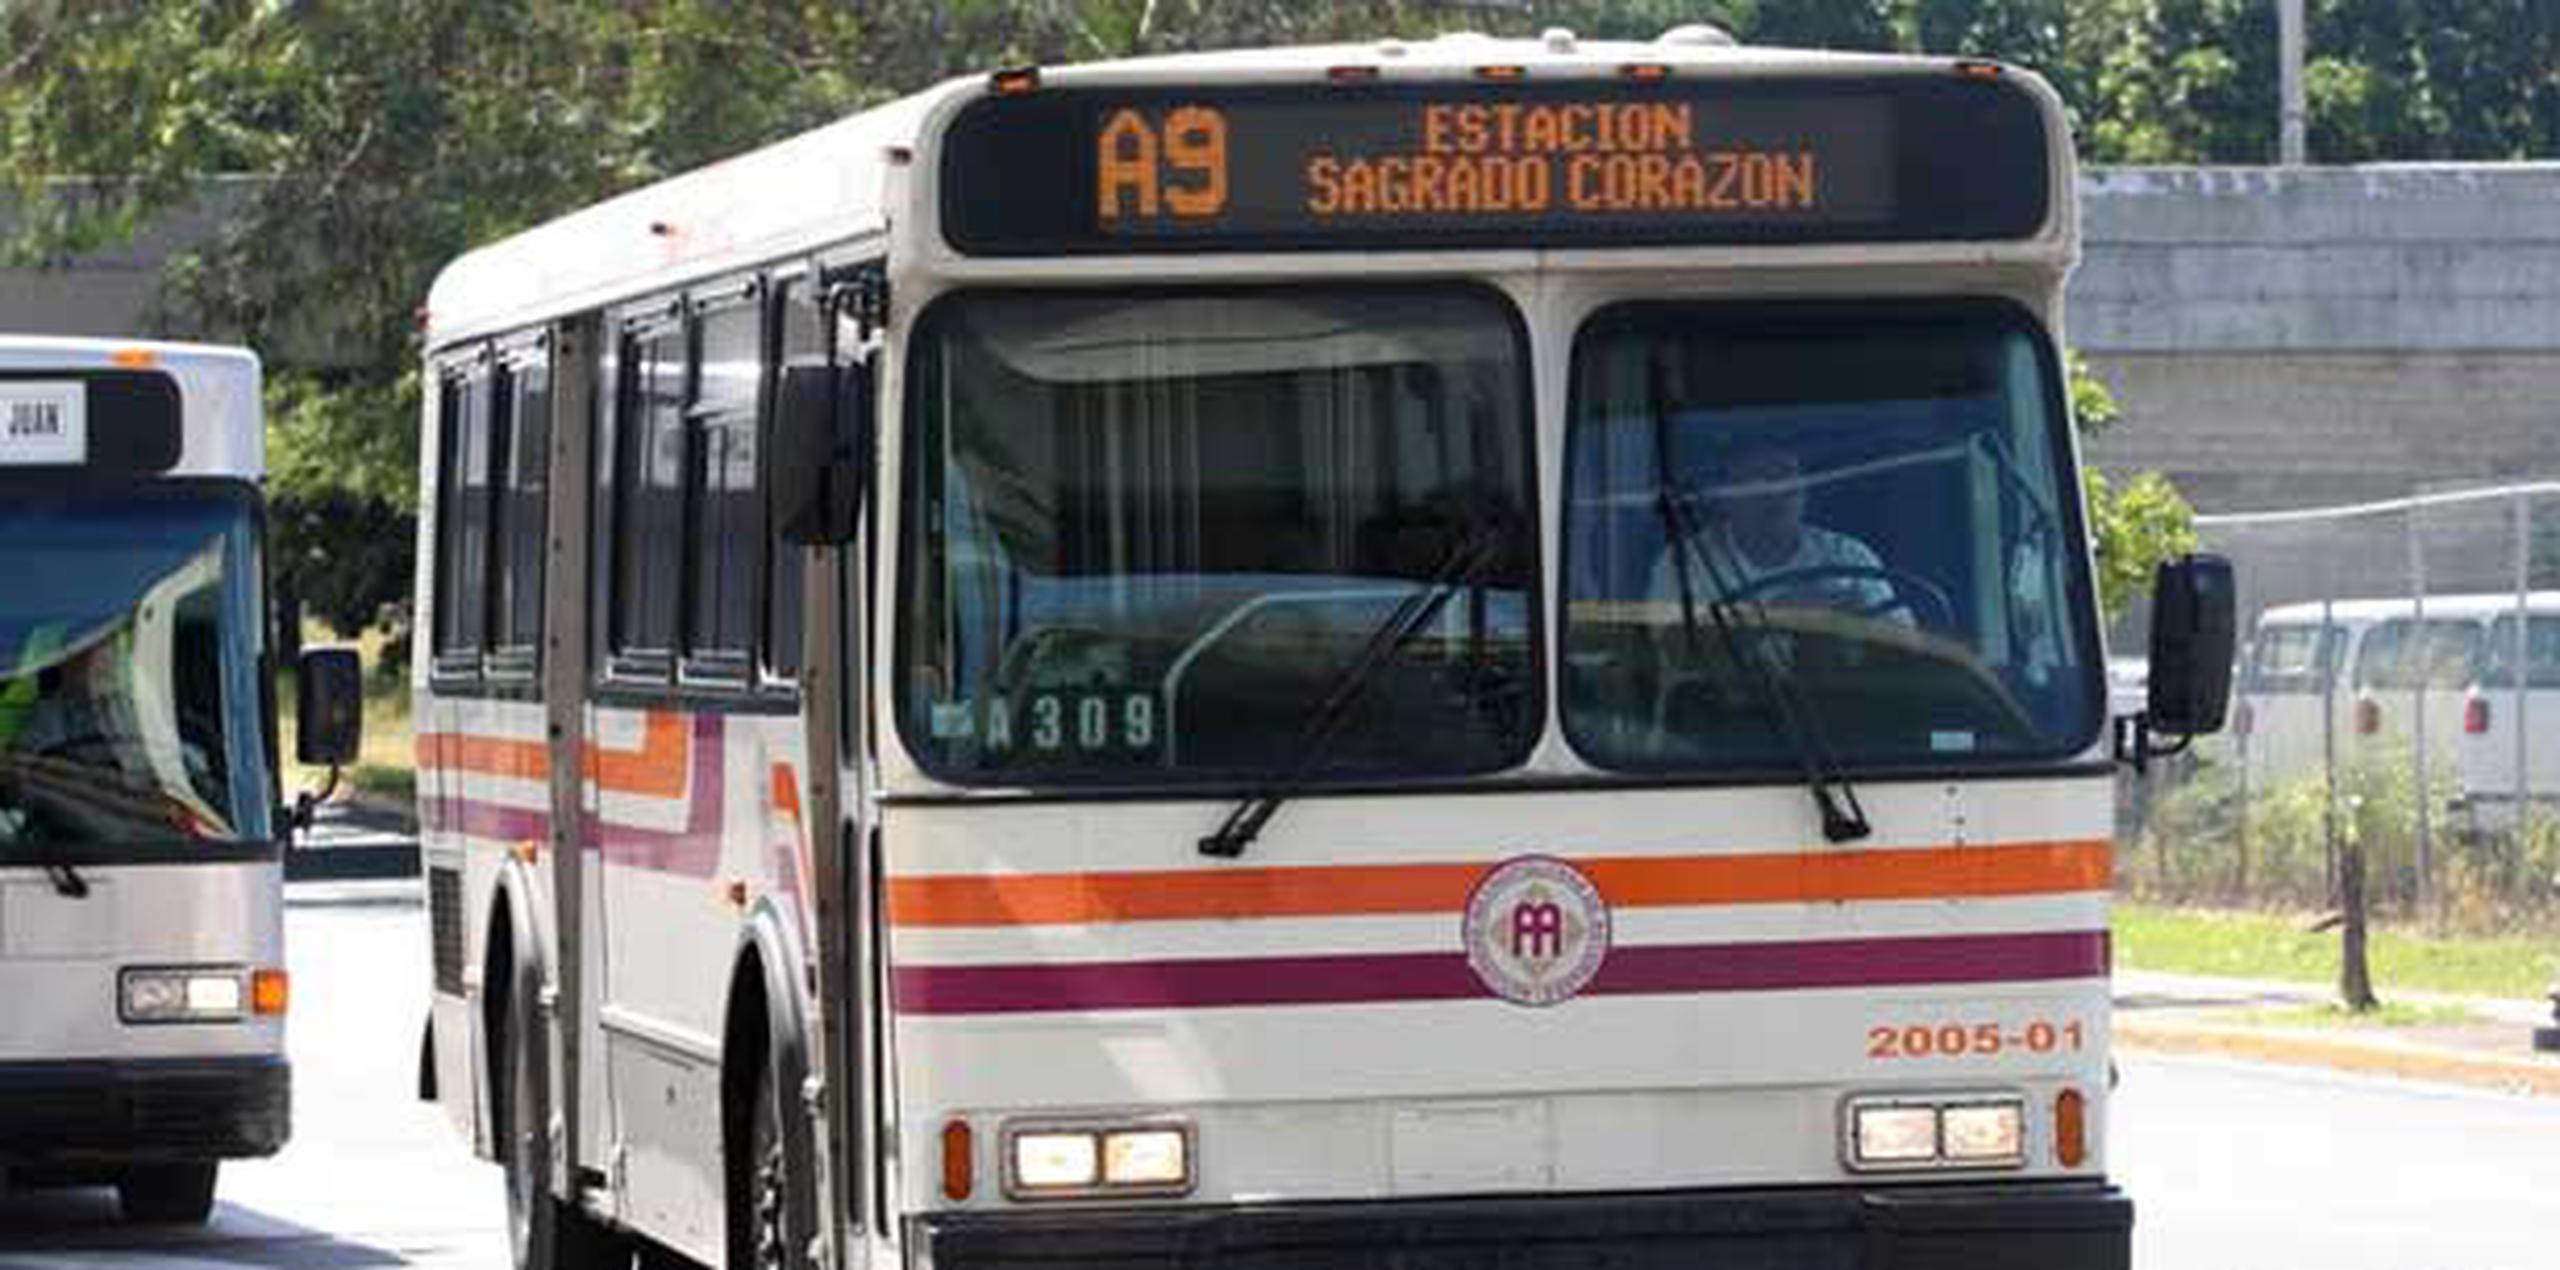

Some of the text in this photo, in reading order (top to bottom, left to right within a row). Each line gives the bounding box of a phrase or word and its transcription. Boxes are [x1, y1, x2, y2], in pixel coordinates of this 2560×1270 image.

[1424, 104, 1692, 153] ESTACION
[1097, 107, 1229, 217] A9
[1307, 152, 1815, 213] SAGRADO CORAZON
[8, 401, 60, 435] JUAN
[1867, 1020, 2084, 1059] 2005-01
